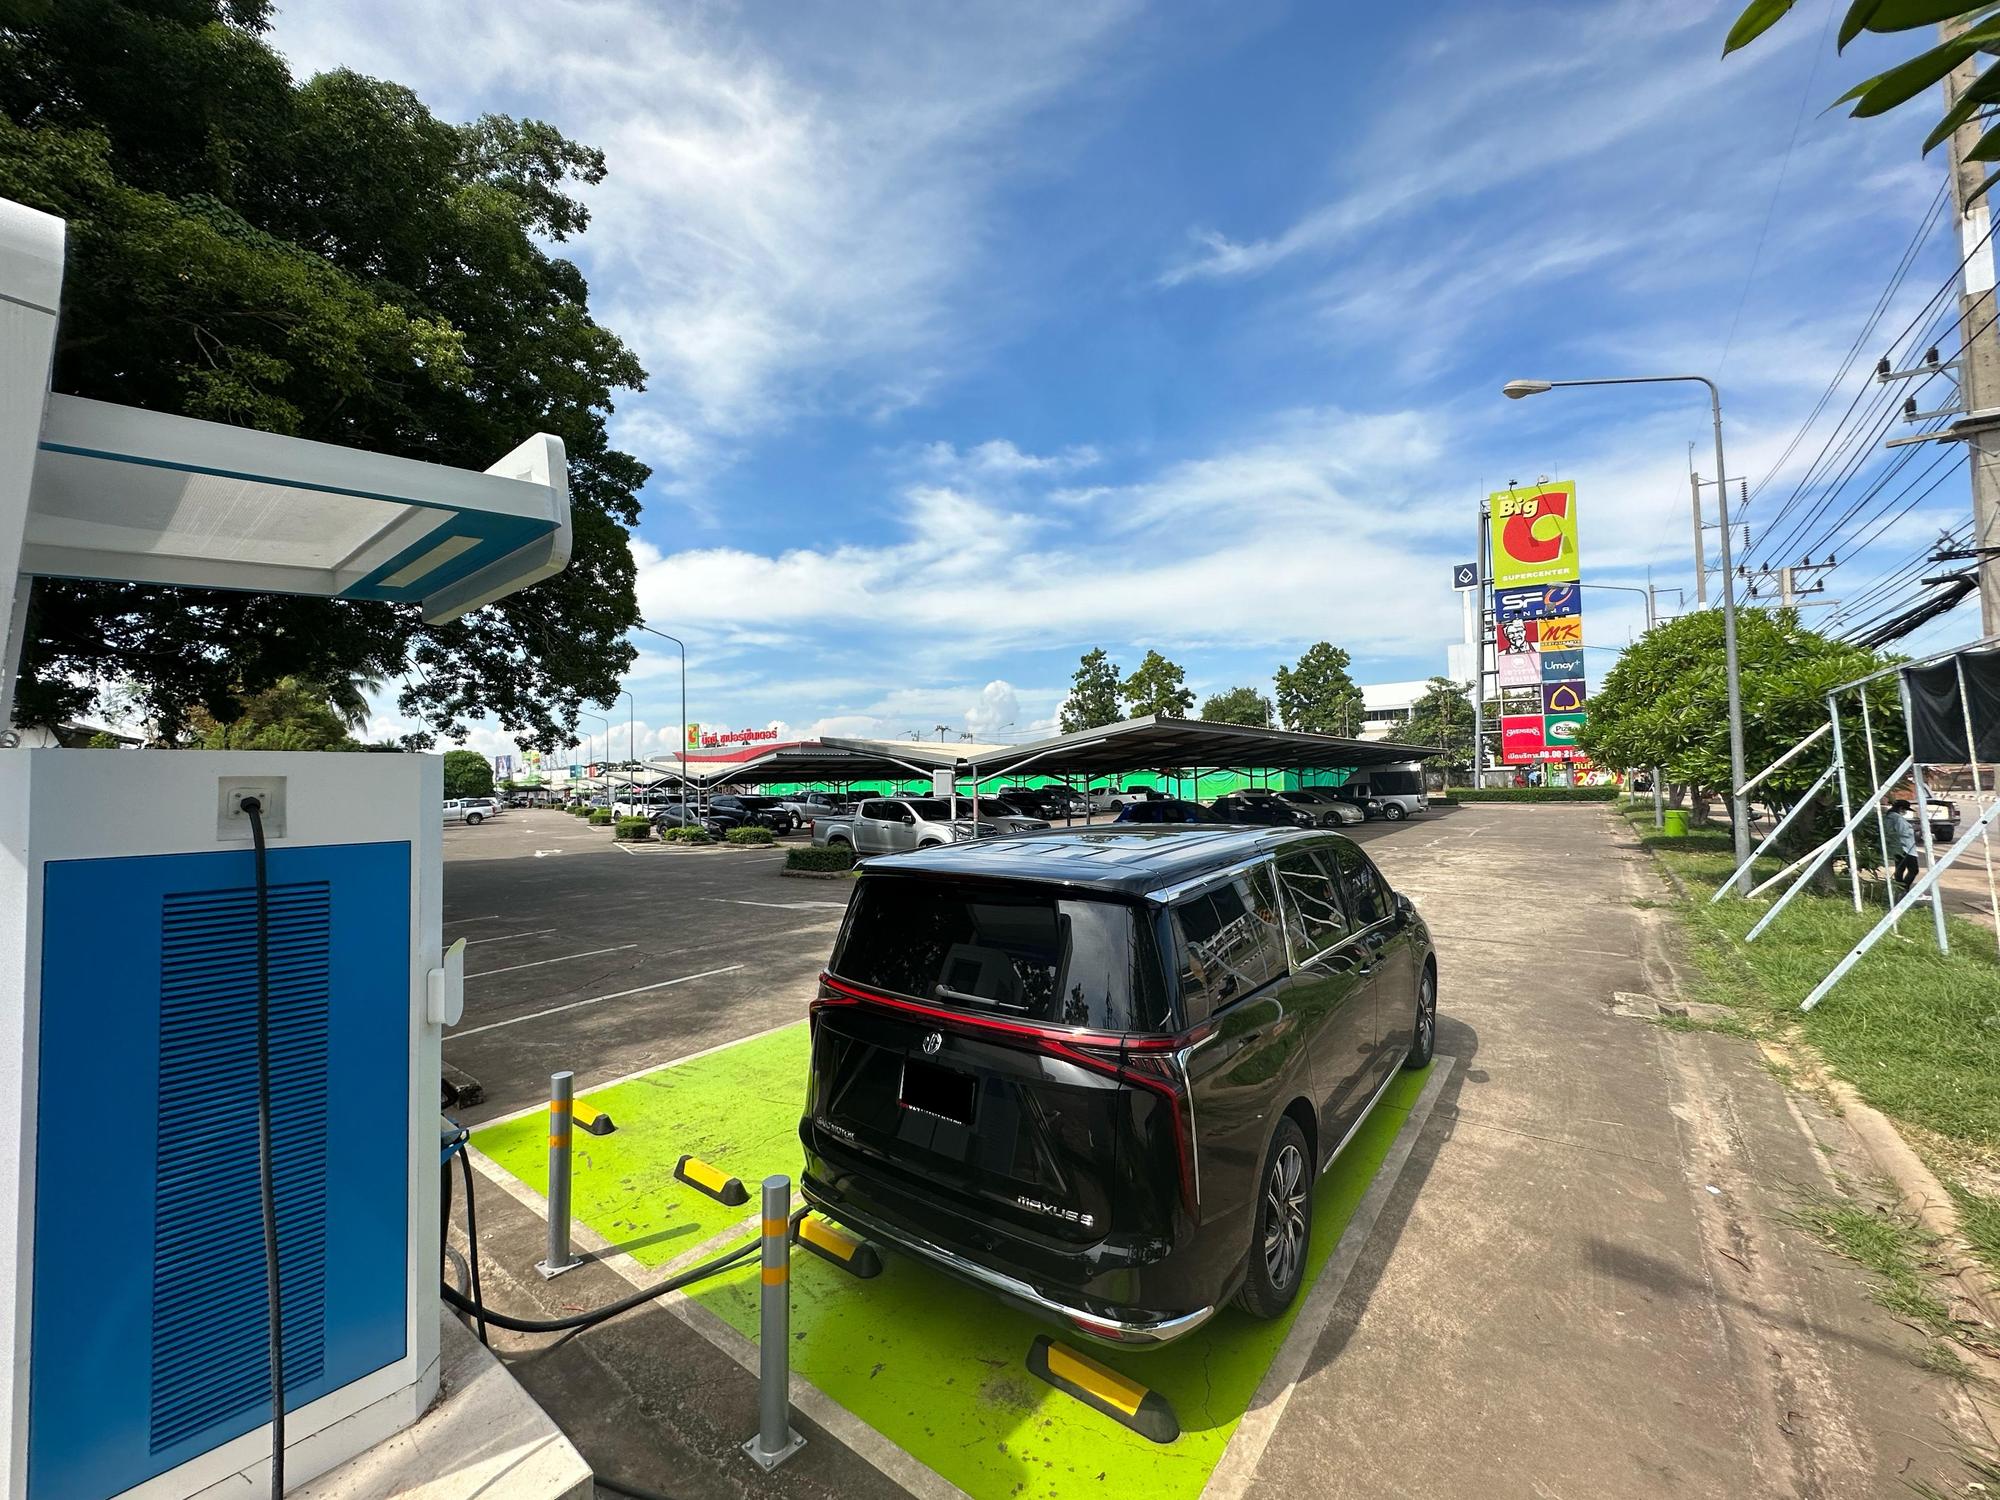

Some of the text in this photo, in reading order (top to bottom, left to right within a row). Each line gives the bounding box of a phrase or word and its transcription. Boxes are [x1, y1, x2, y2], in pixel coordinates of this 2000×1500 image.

[1500, 492, 1570, 564] Big C
[1502, 568, 1570, 582] SUPERCENTER
[1541, 624, 1579, 641] MK
